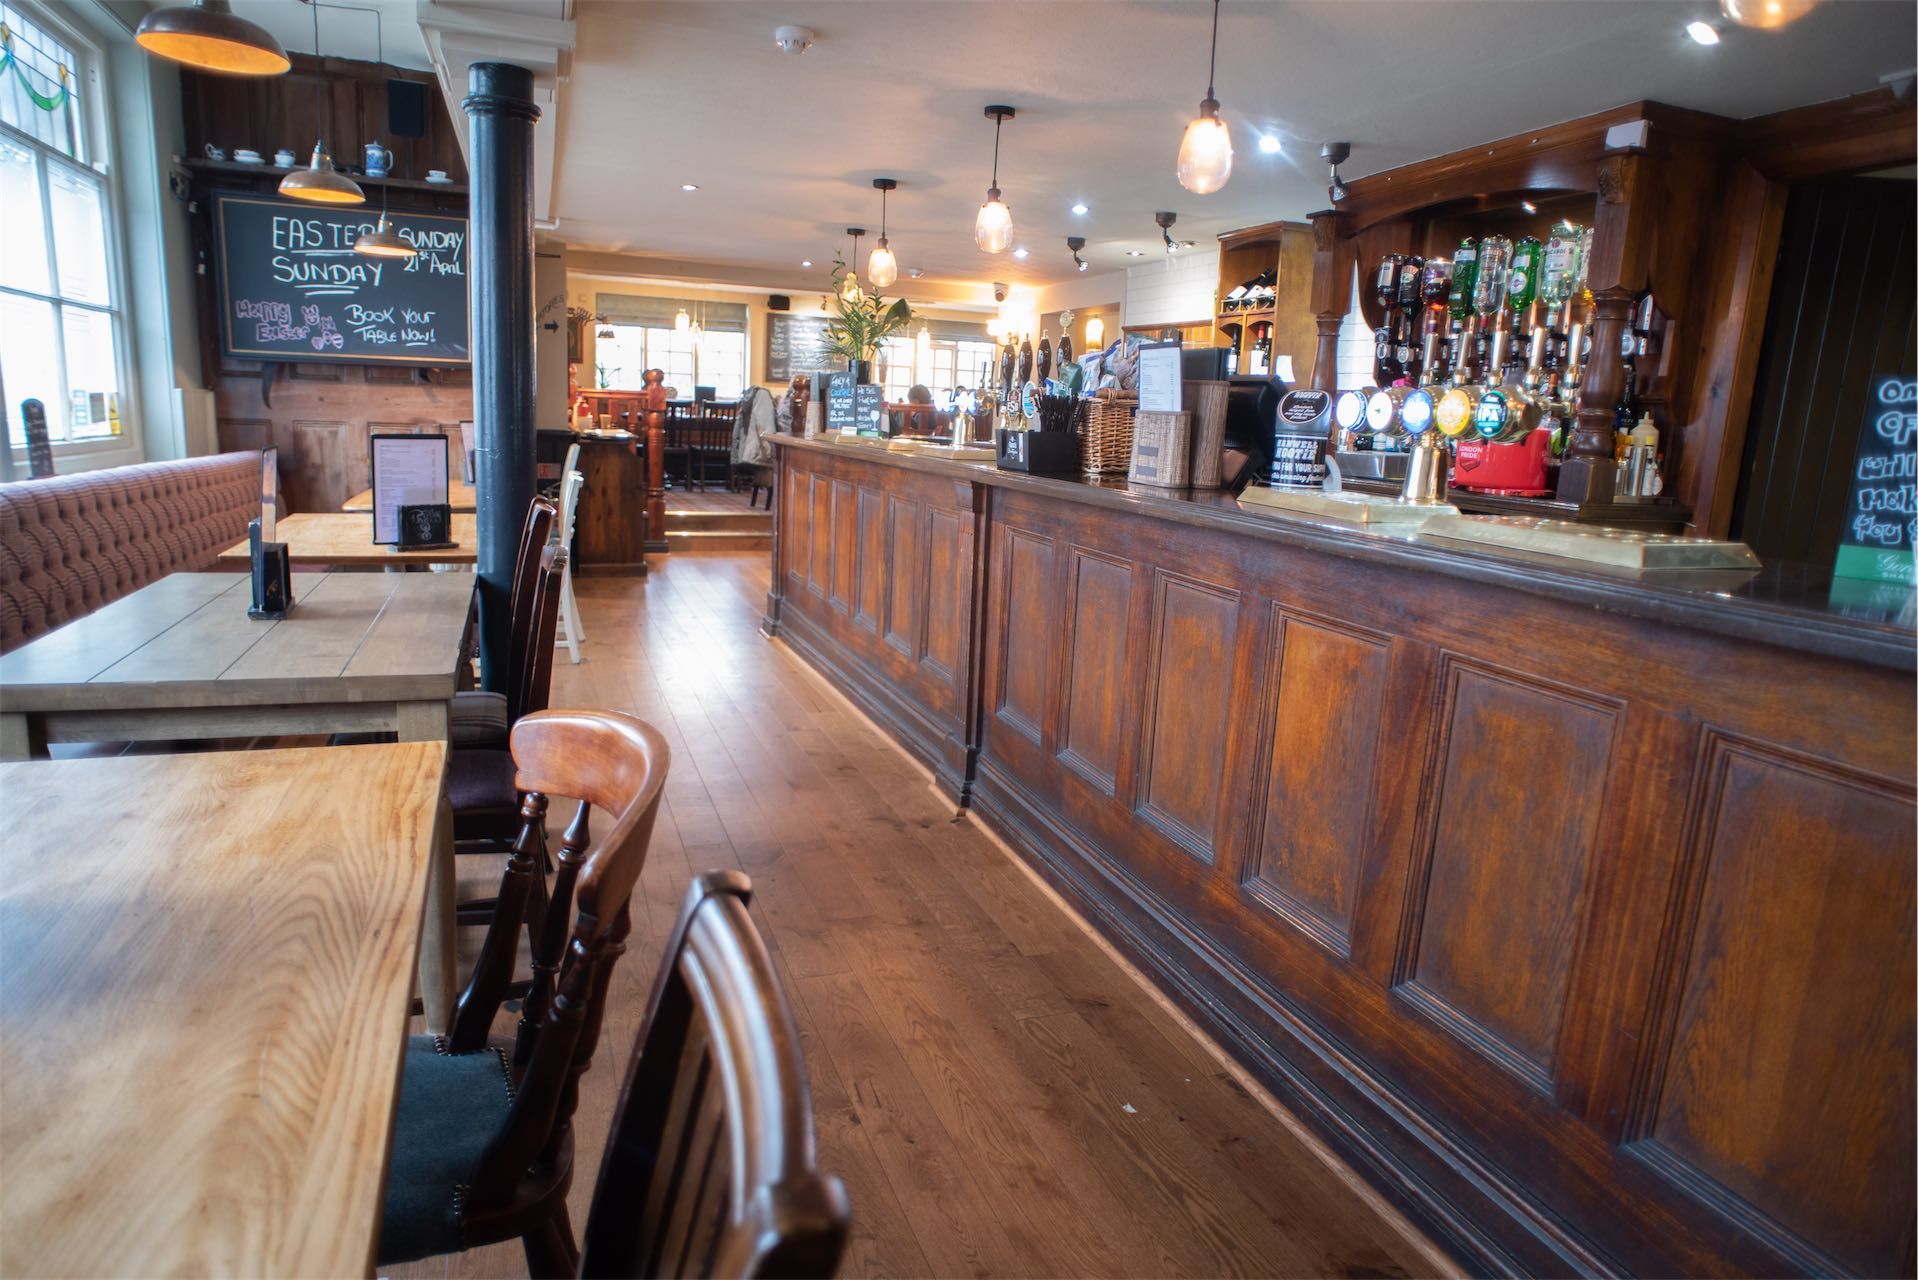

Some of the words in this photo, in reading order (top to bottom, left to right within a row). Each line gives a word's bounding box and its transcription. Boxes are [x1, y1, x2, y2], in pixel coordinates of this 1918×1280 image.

[398, 227, 465, 261] SUNDAY
[272, 256, 382, 286] SUNDAY
[353, 325, 397, 344] TABLE
[1478, 404, 1500, 422] IPA
[1459, 445, 1483, 453] LONDON
[1281, 462, 1293, 472] FOR
[1295, 463, 1312, 473] YOUR
